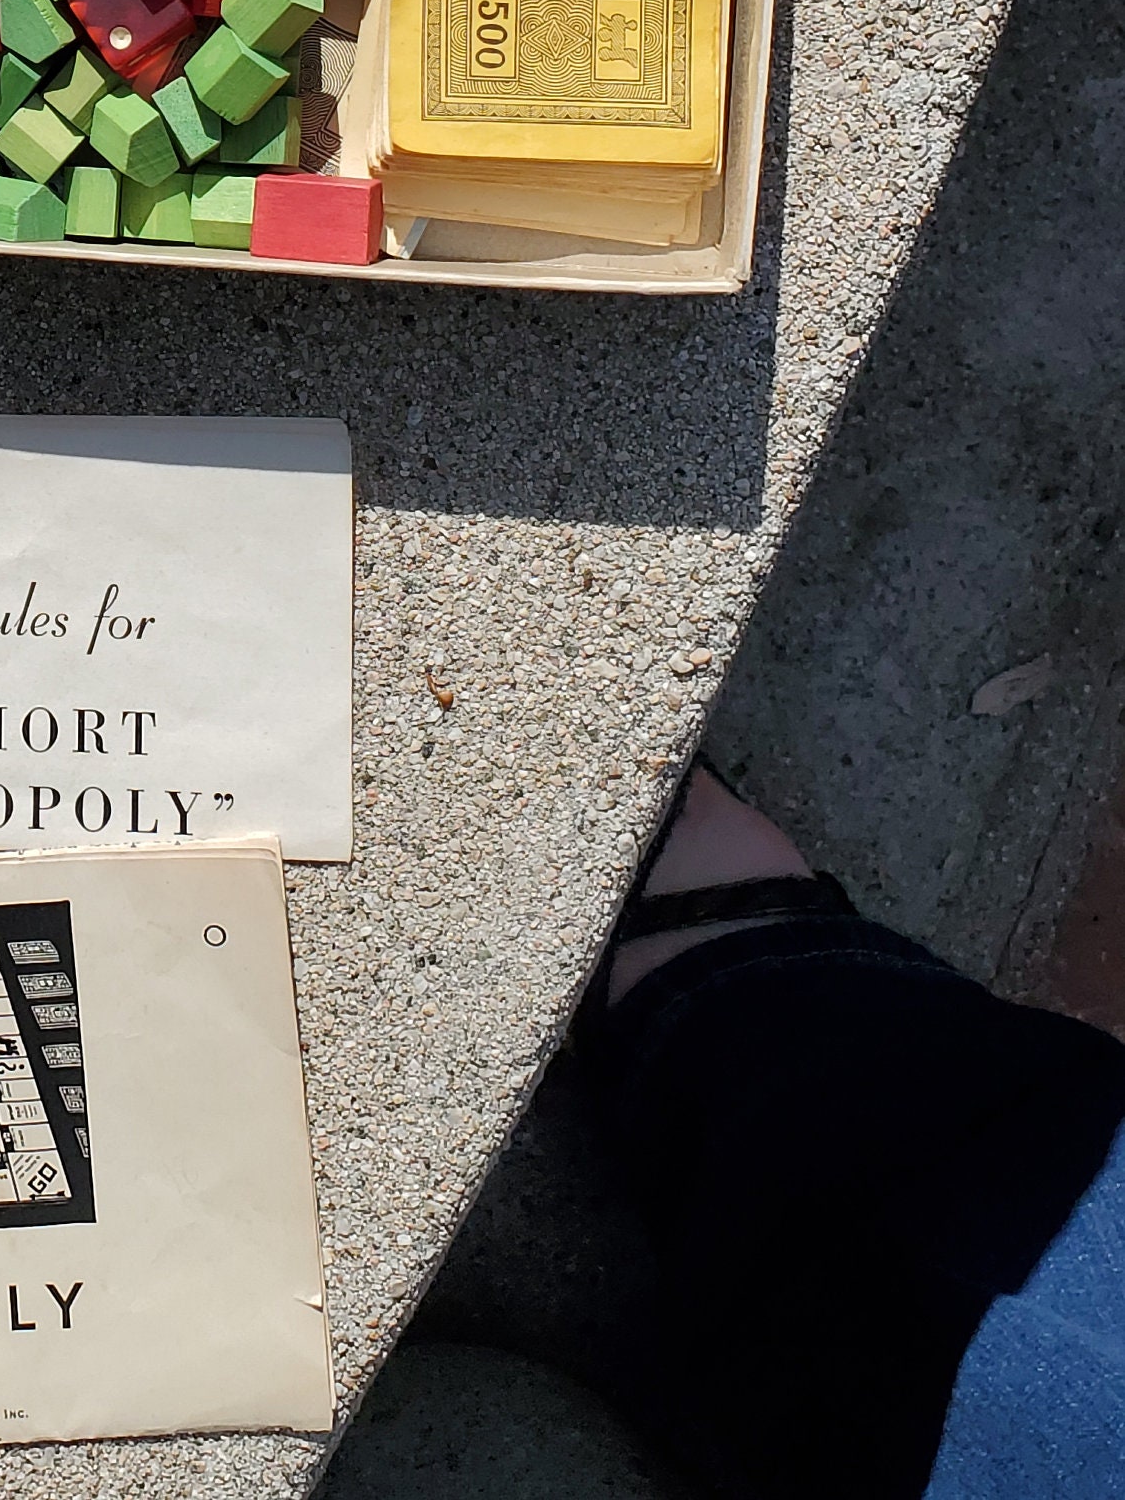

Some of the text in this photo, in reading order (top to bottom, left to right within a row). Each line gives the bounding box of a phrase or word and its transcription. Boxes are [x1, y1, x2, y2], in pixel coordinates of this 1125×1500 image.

[475, 0, 508, 70] 500
[86, 583, 156, 655] for
[27, 1162, 58, 1194] GO
